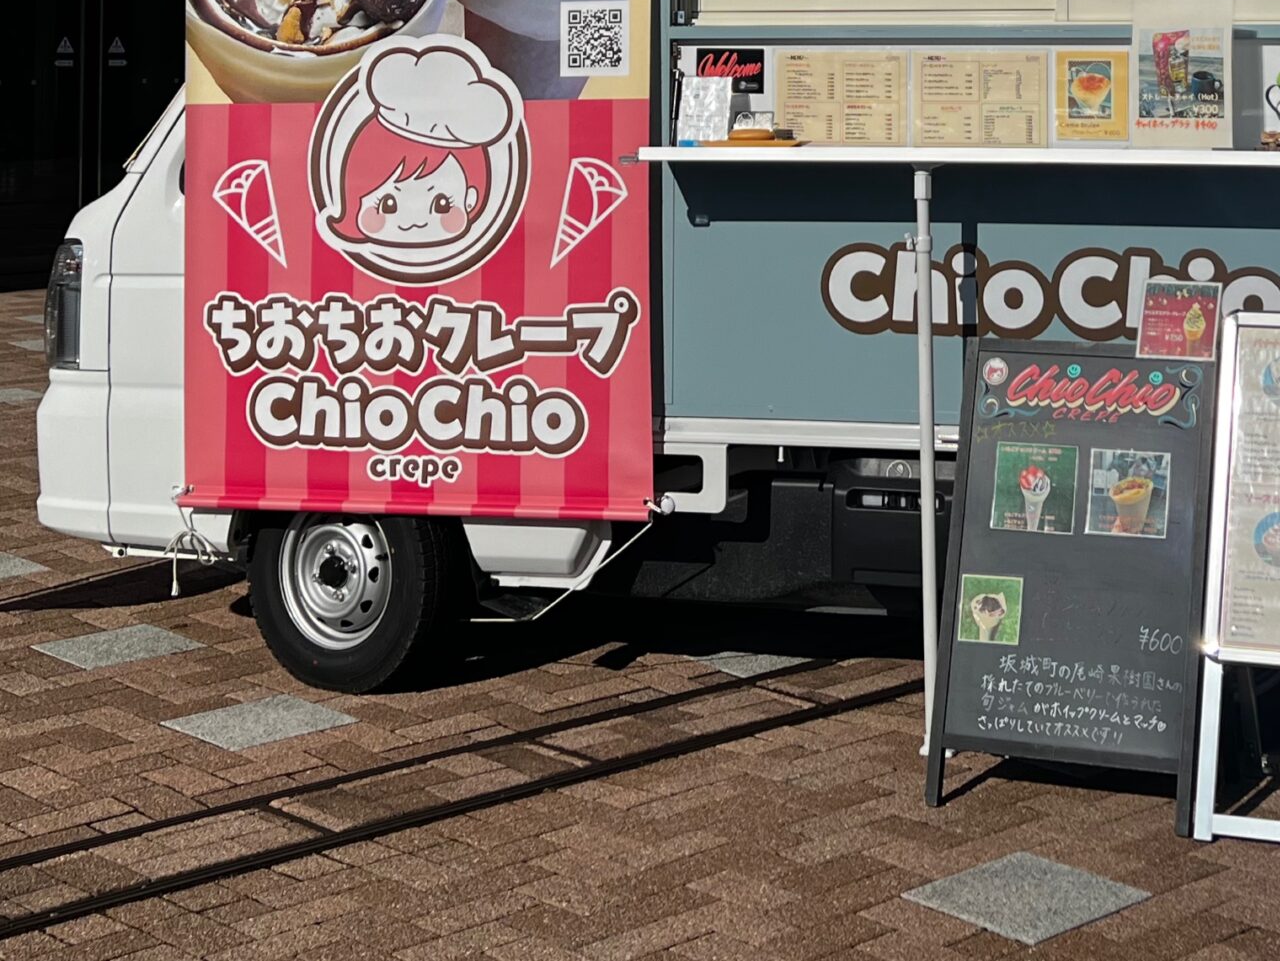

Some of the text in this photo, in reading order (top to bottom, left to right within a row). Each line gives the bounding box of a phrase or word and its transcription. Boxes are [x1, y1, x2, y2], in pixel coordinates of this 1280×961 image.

[698, 51, 762, 78] Welcome
[1192, 103, 1219, 115] ¥300
[207, 289, 639, 376] ちおちおクレープ
[250, 377, 585, 453] ChioChio
[1052, 407, 1123, 424] CREPE
[369, 456, 459, 481] crepe
[1138, 624, 1184, 655] ¥600
